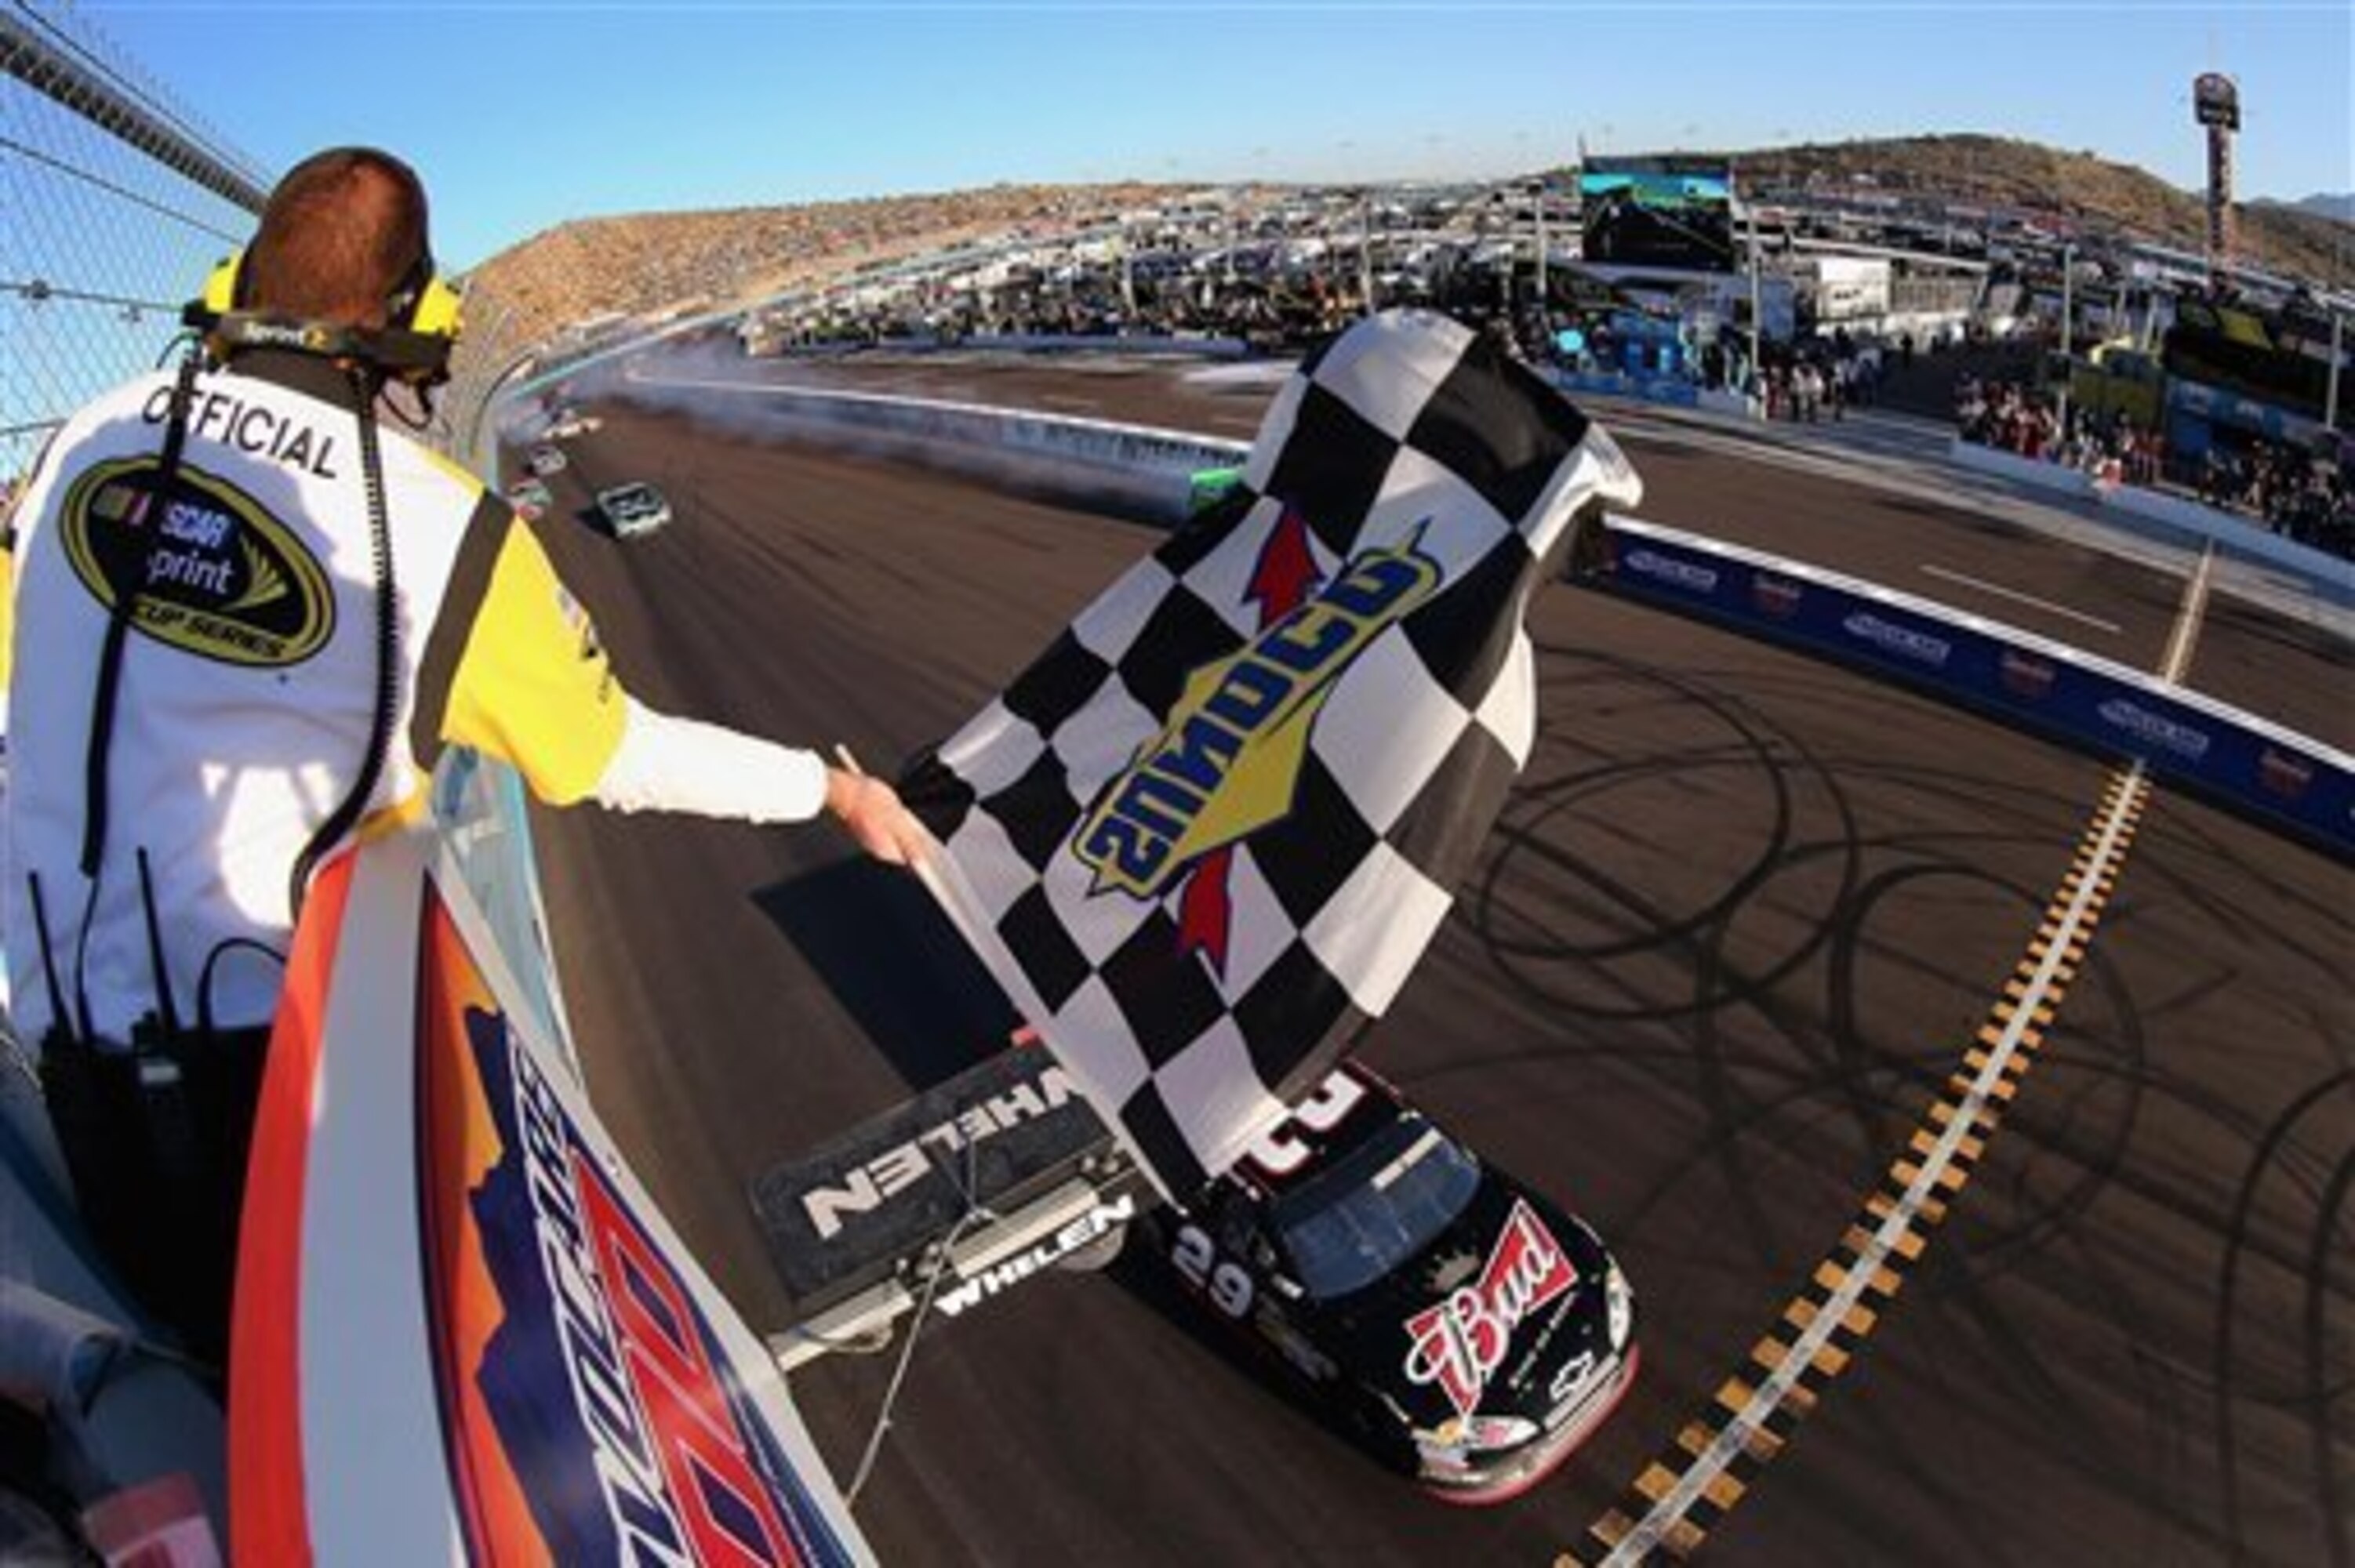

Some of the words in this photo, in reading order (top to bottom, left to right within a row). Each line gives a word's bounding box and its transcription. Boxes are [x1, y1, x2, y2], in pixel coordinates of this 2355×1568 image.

[142, 385, 336, 479] OFICIAL
[160, 503, 231, 547] SCAR
[147, 550, 234, 595] print
[934, 1193, 1132, 1316] WHELEN
[1172, 1225, 1253, 1319] 29
[1405, 1213, 1559, 1392] Bud
